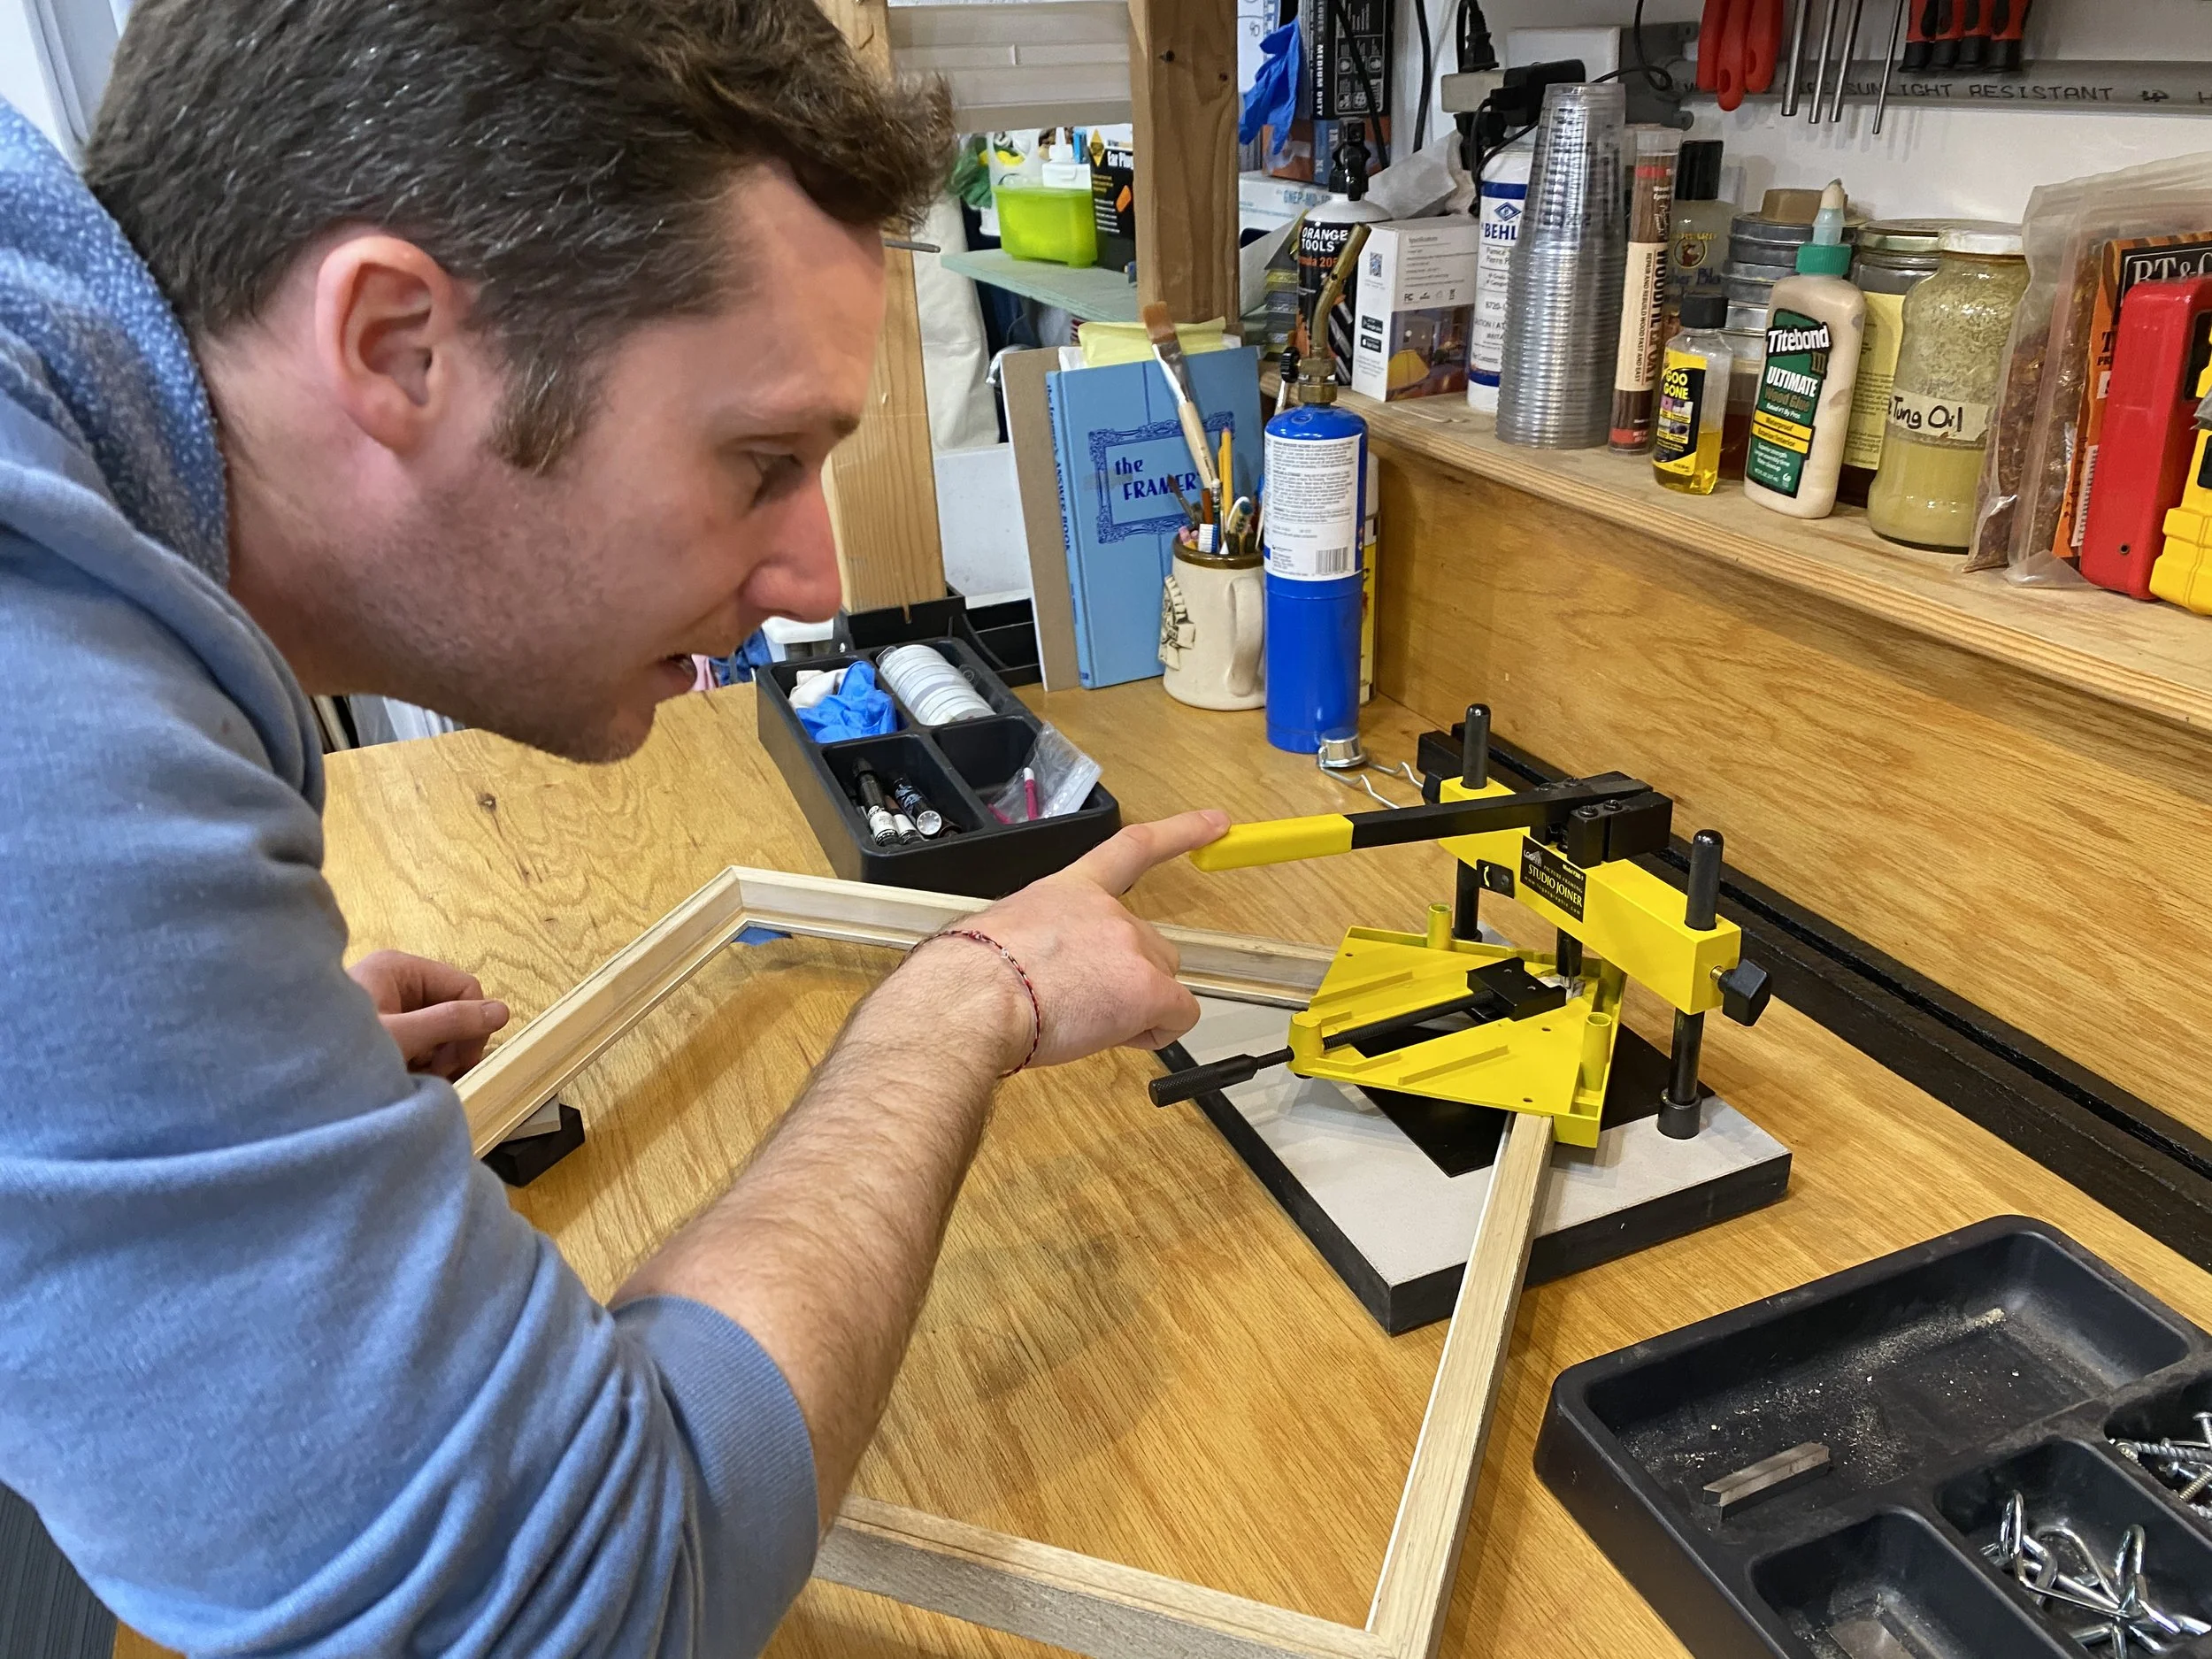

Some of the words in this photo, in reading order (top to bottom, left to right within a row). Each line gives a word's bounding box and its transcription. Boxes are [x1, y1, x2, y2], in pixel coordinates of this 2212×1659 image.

[1970, 84, 2113, 101] RESISTANT
[1302, 227, 1348, 242] ORANGE
[1302, 239, 1335, 252] TOOLS
[1638, 316, 1647, 337] WOOD
[1768, 325, 1830, 353] Titebond
[1666, 370, 1688, 387] GOO
[1766, 365, 1818, 397] ULTIMATE
[1663, 382, 1689, 400] GONE
[1765, 387, 1788, 405] Wood
[1789, 395, 1810, 412] Glue
[1893, 395, 1922, 430] Tung
[1927, 404, 1962, 433] Oil
[1115, 457, 1143, 475] the
[1528, 864, 1555, 889] STUDIO
[1555, 882, 1583, 908] JOINER
